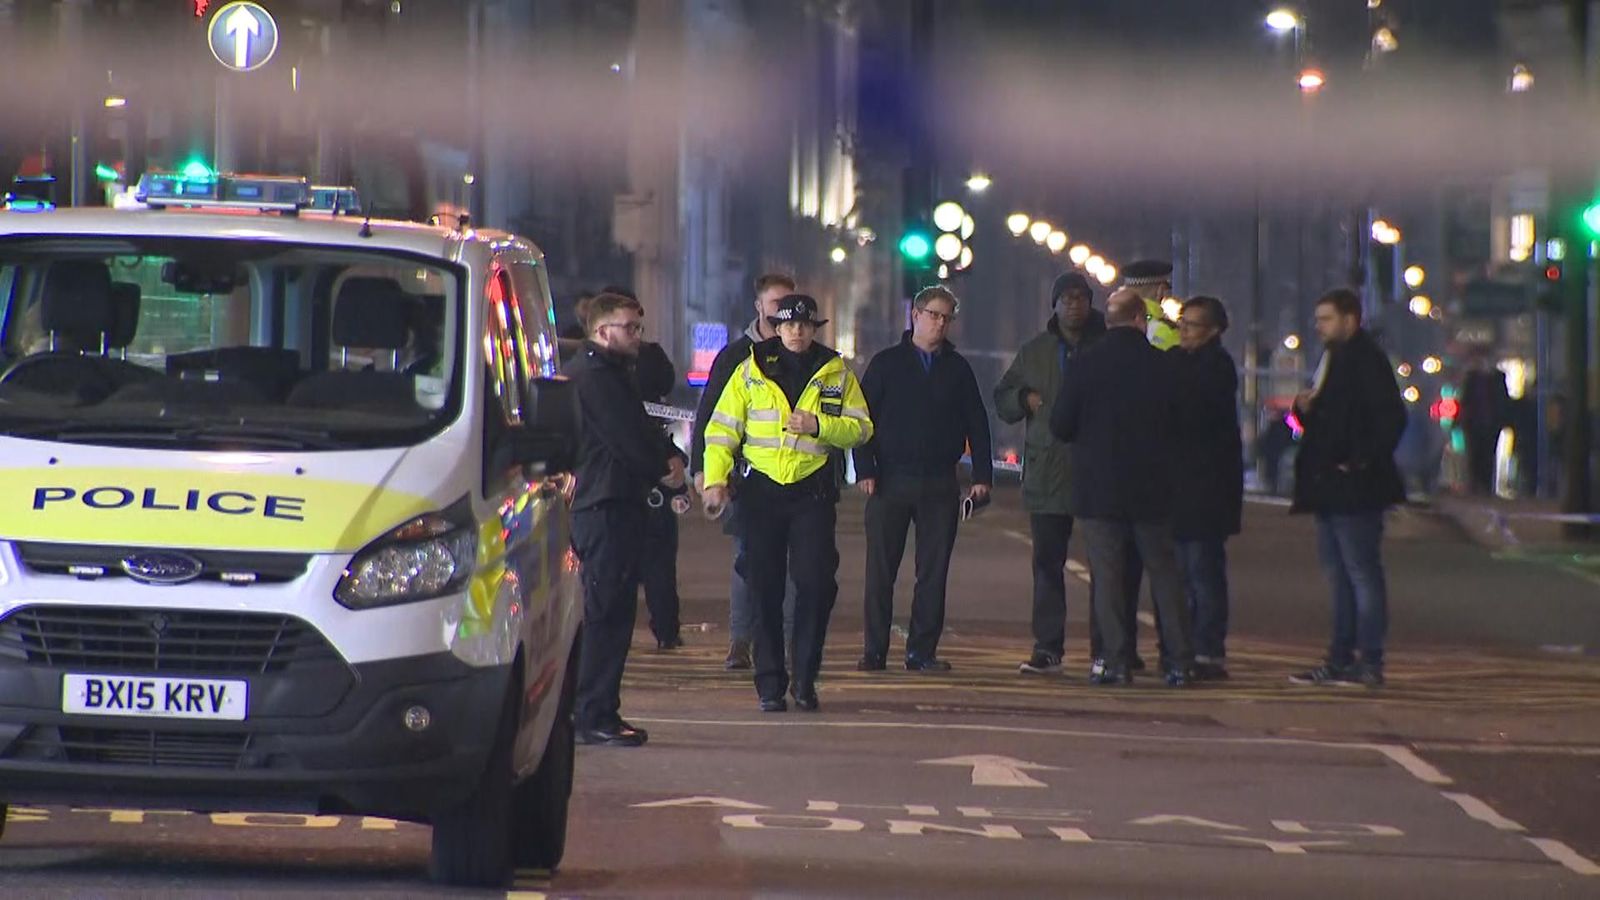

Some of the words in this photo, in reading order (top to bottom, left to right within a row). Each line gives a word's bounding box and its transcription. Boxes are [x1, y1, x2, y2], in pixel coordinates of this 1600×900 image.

[32, 486, 306, 521] POLICE
[85, 679, 155, 711] BX15
[164, 683, 226, 713] KRV
